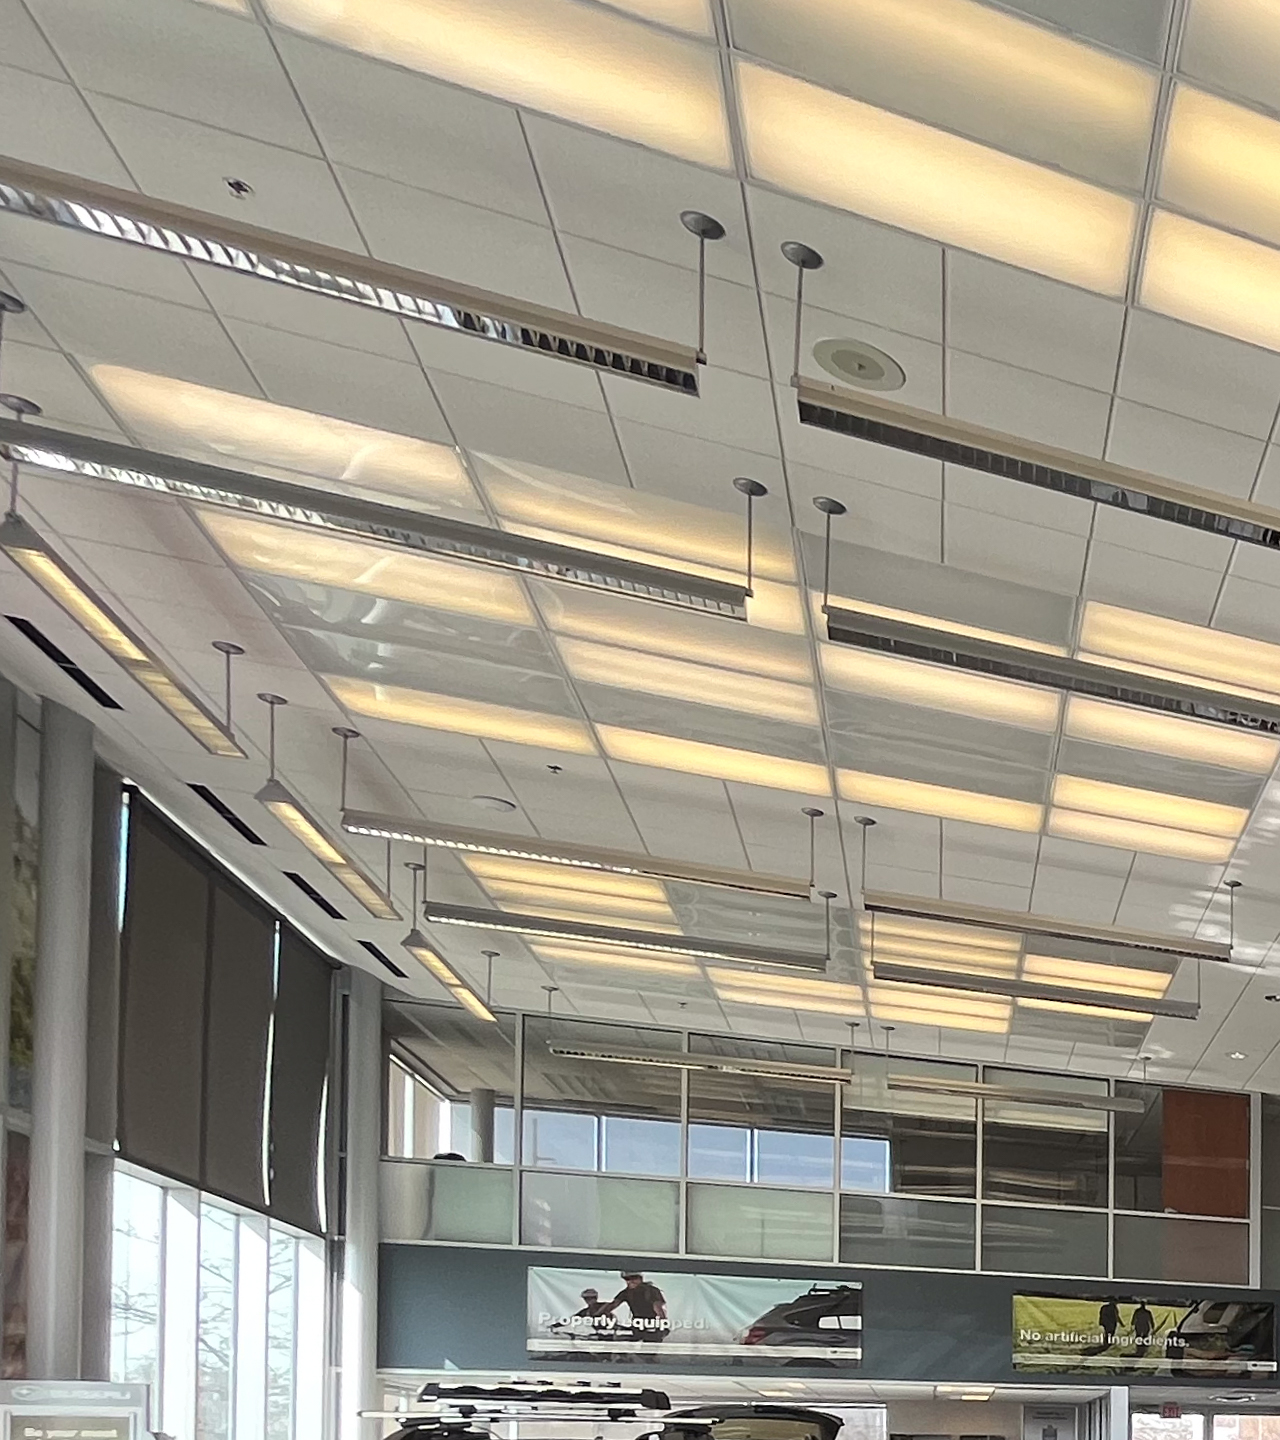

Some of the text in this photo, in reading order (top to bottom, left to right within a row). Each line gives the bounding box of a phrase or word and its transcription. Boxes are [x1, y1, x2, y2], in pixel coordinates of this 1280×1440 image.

[538, 1311, 617, 1329] Properly
[1020, 1329, 1190, 1348] No artificial ingredients.
